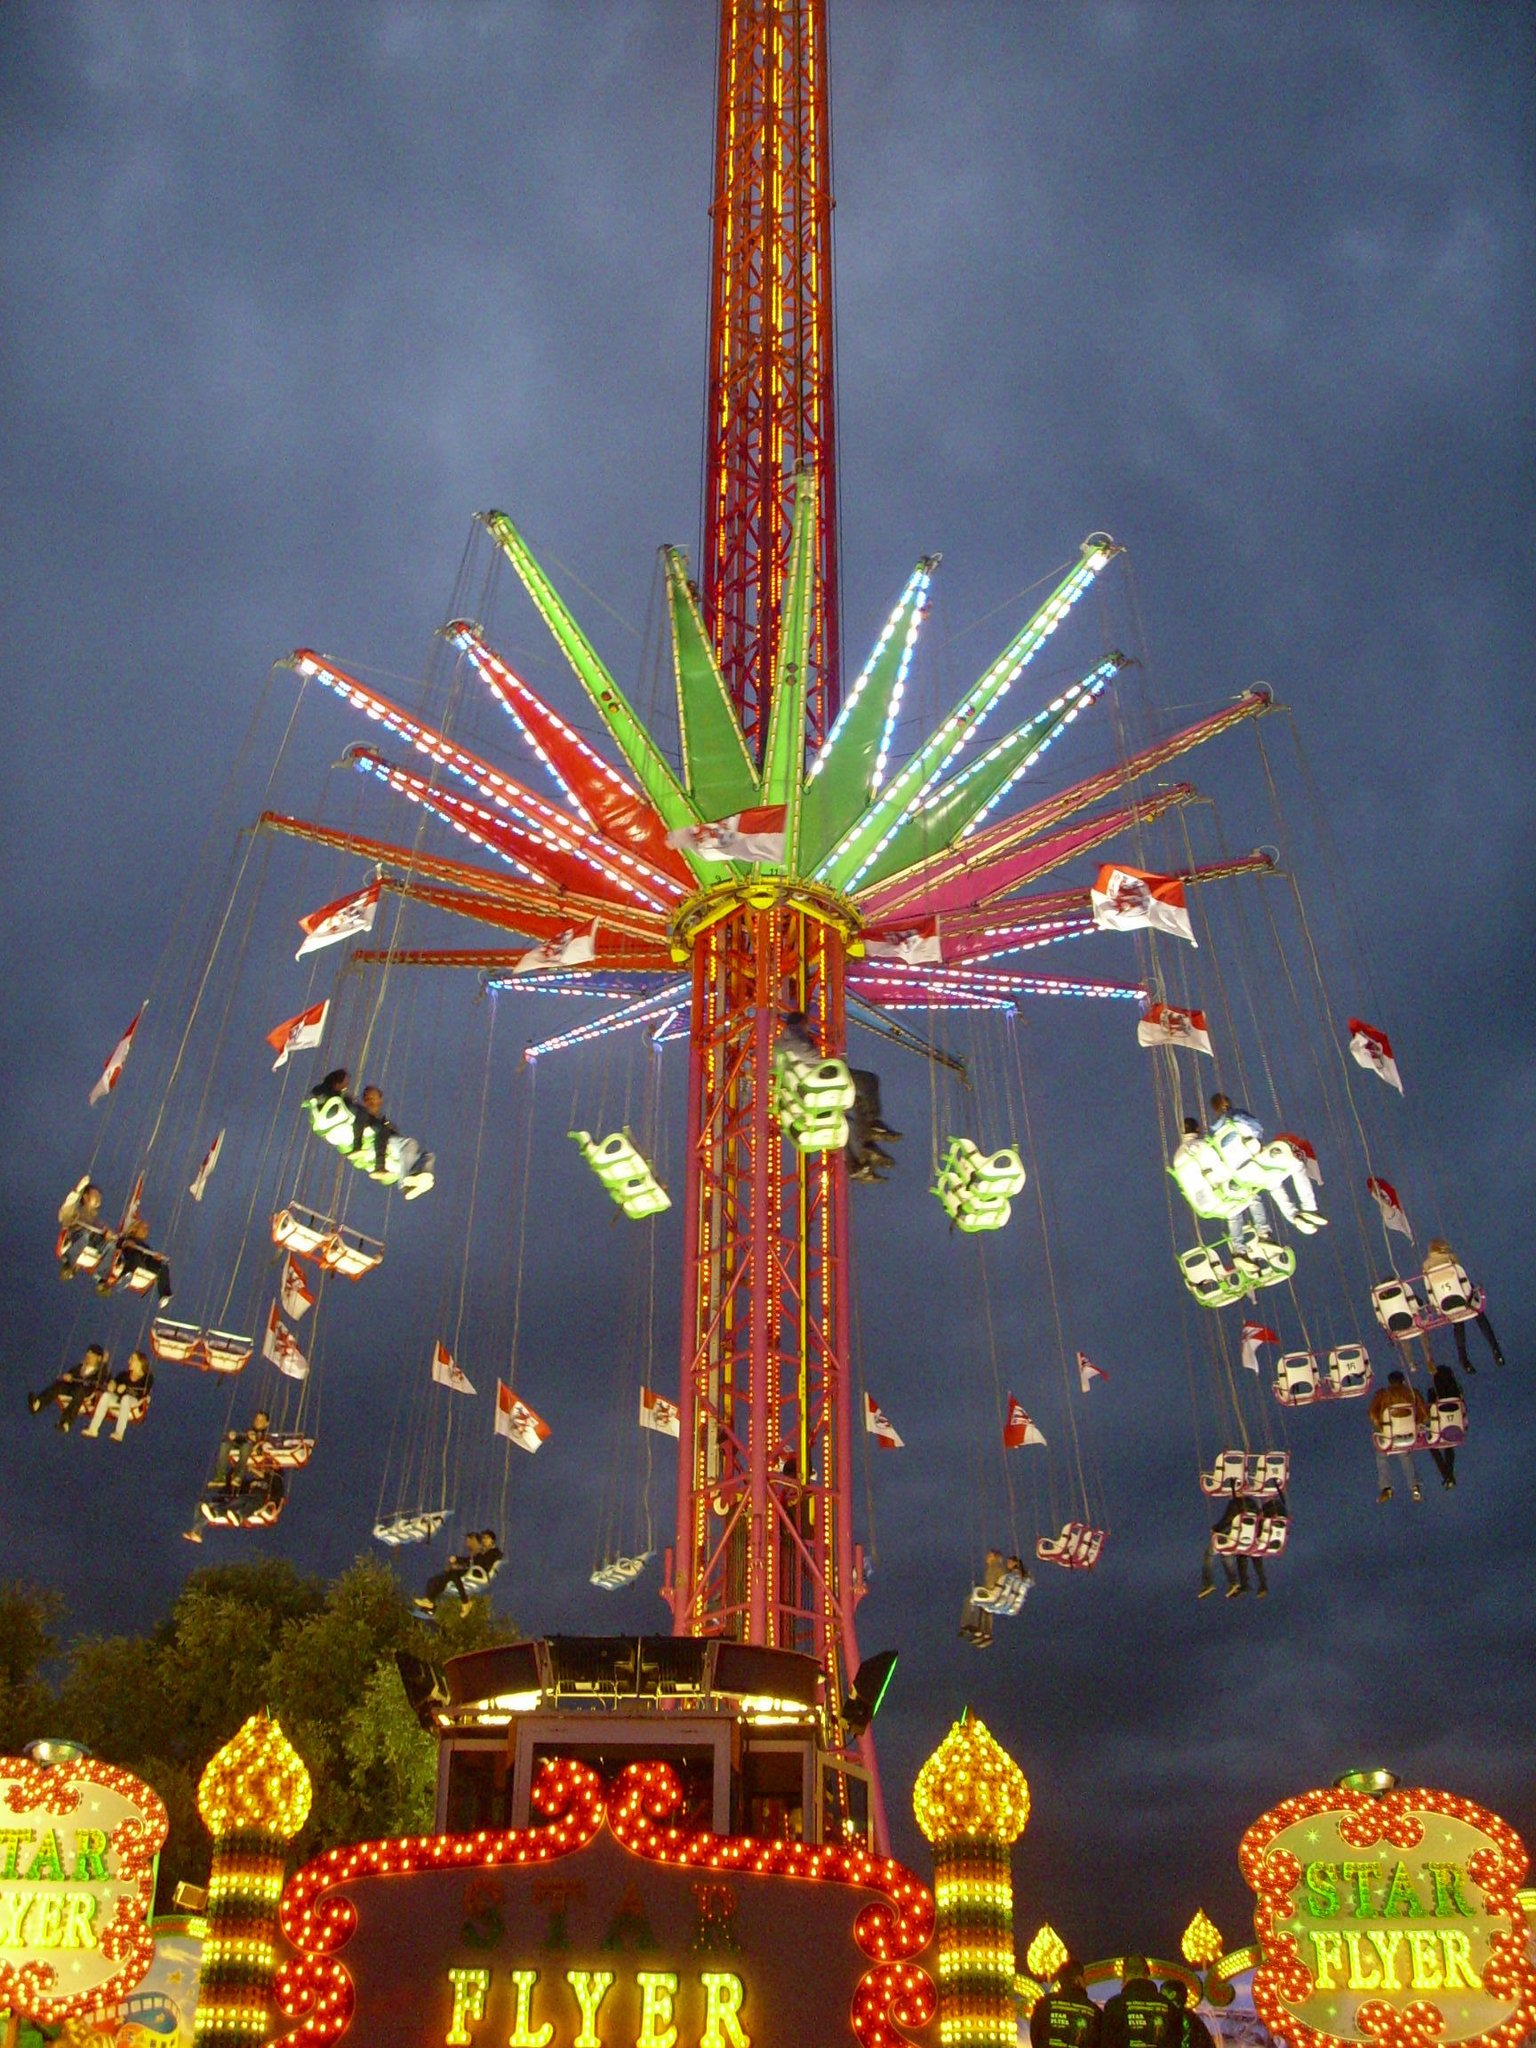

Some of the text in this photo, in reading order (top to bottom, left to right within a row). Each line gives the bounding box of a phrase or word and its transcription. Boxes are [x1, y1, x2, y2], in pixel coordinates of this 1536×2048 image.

[461, 1876, 741, 1951] STAR
[1306, 1860, 1477, 1918] STAR
[0, 1892, 98, 1948] YER
[1309, 1930, 1483, 1990] FLYER
[446, 1968, 751, 2048] FLYER
